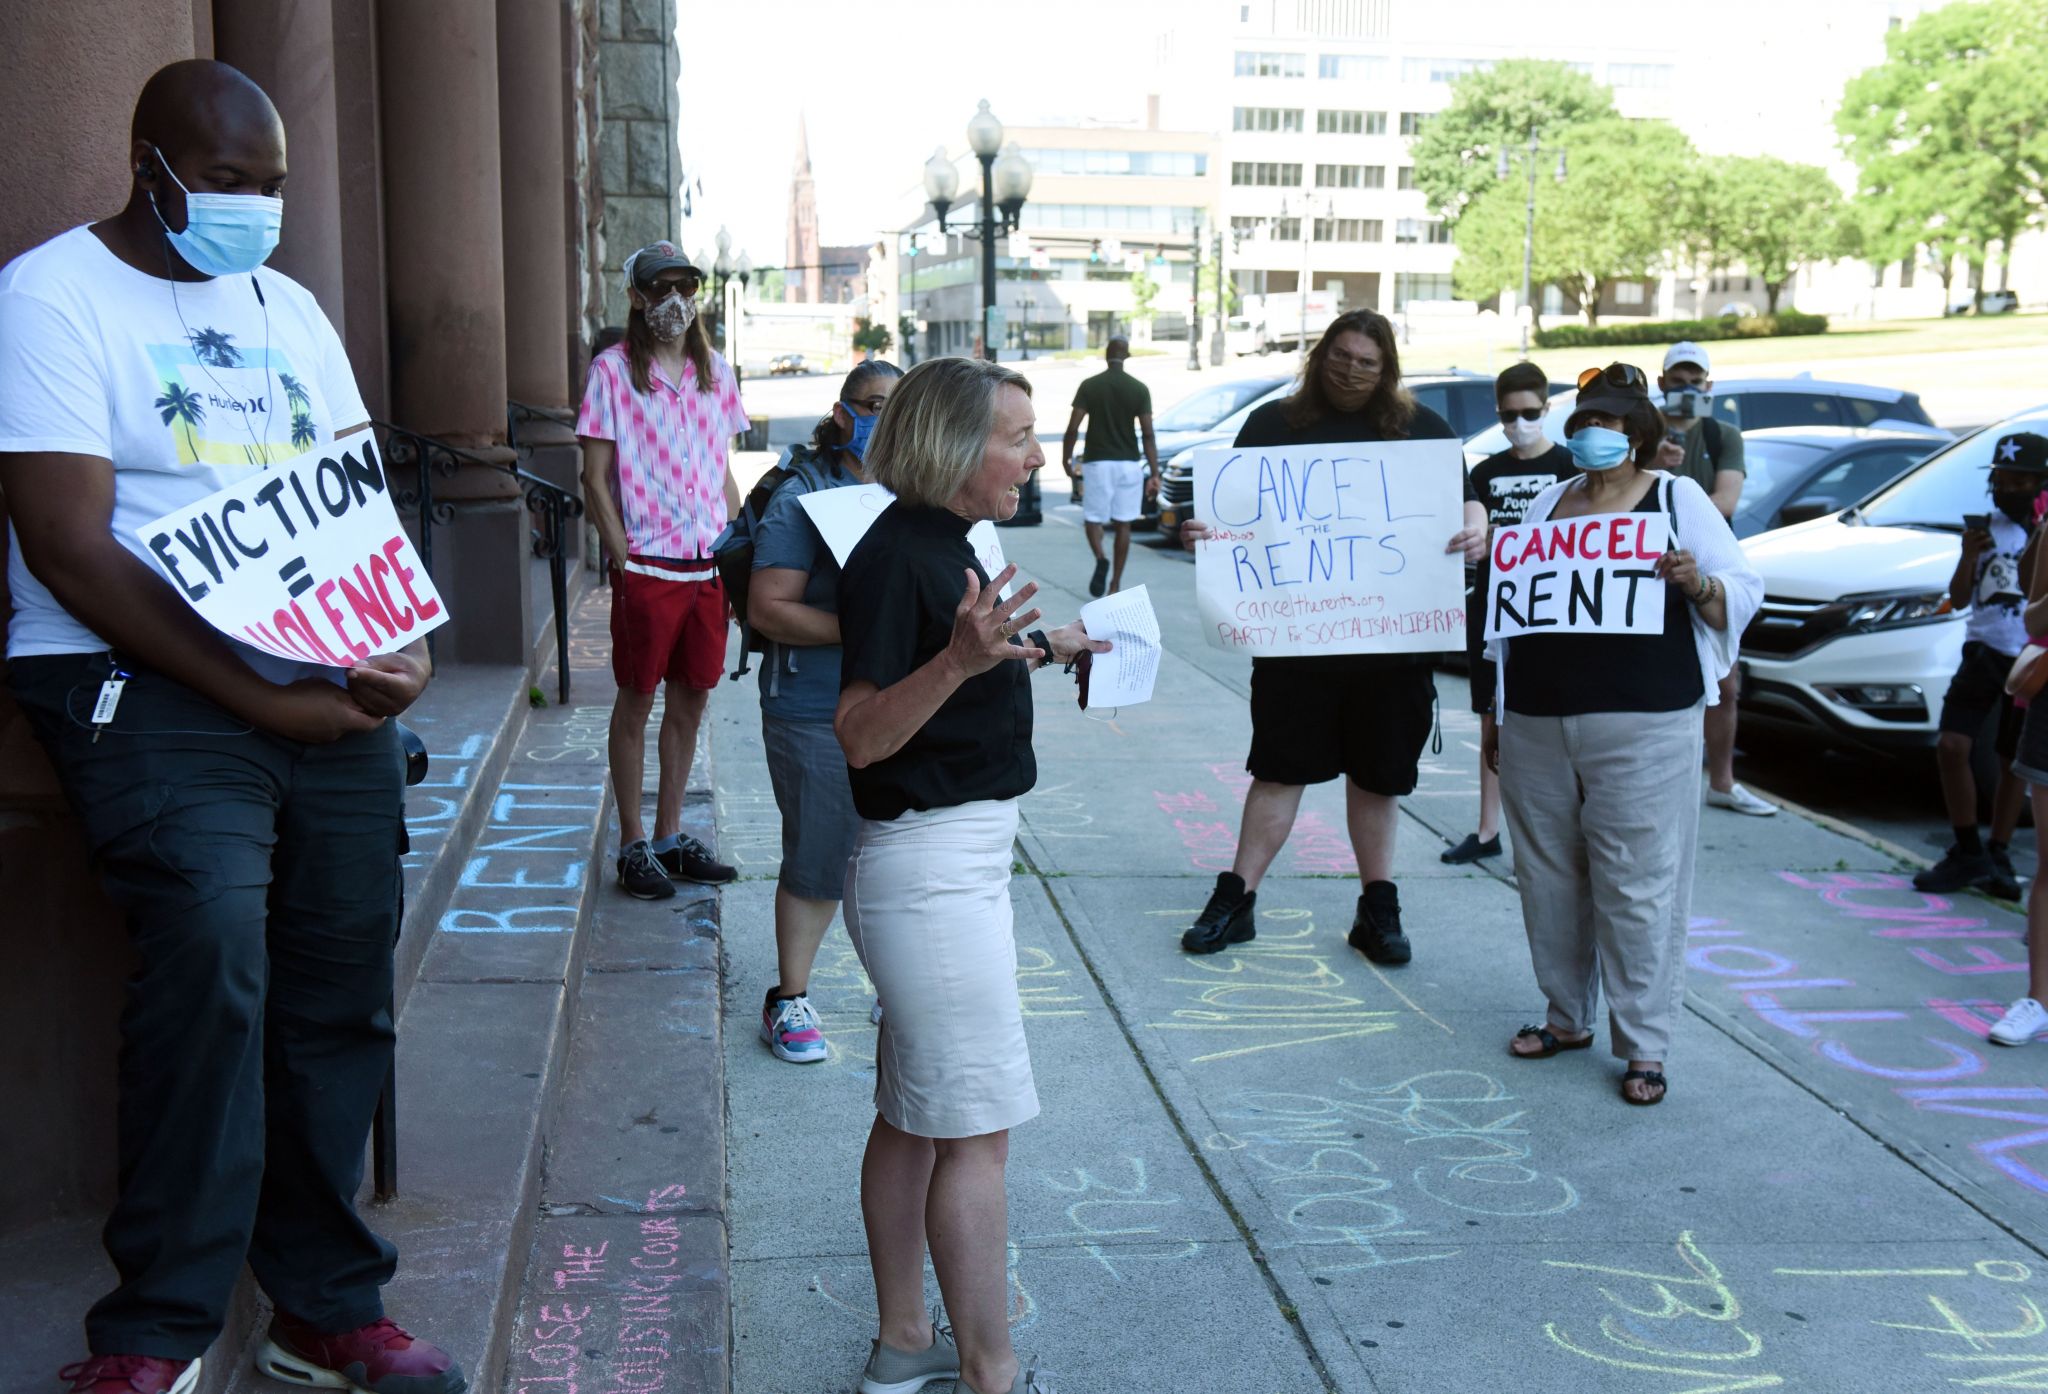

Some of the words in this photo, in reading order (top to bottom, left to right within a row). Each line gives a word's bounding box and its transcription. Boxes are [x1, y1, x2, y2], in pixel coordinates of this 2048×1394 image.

[208, 393, 247, 414] Hurley
[1211, 453, 1437, 527] CANCEL
[1489, 508, 1526, 523] Peopl
[148, 438, 386, 603] EVICTION
[1296, 523, 1332, 536] THE
[1494, 517, 1663, 572] CANCEL
[1232, 534, 1406, 593] RENTS
[230, 535, 440, 669] VIOLENCE
[1235, 593, 1386, 622] canceltherents.org
[1494, 567, 1656, 632] RENT
[1217, 621, 1278, 647] PARTY
[553, 1239, 610, 1290] THE
